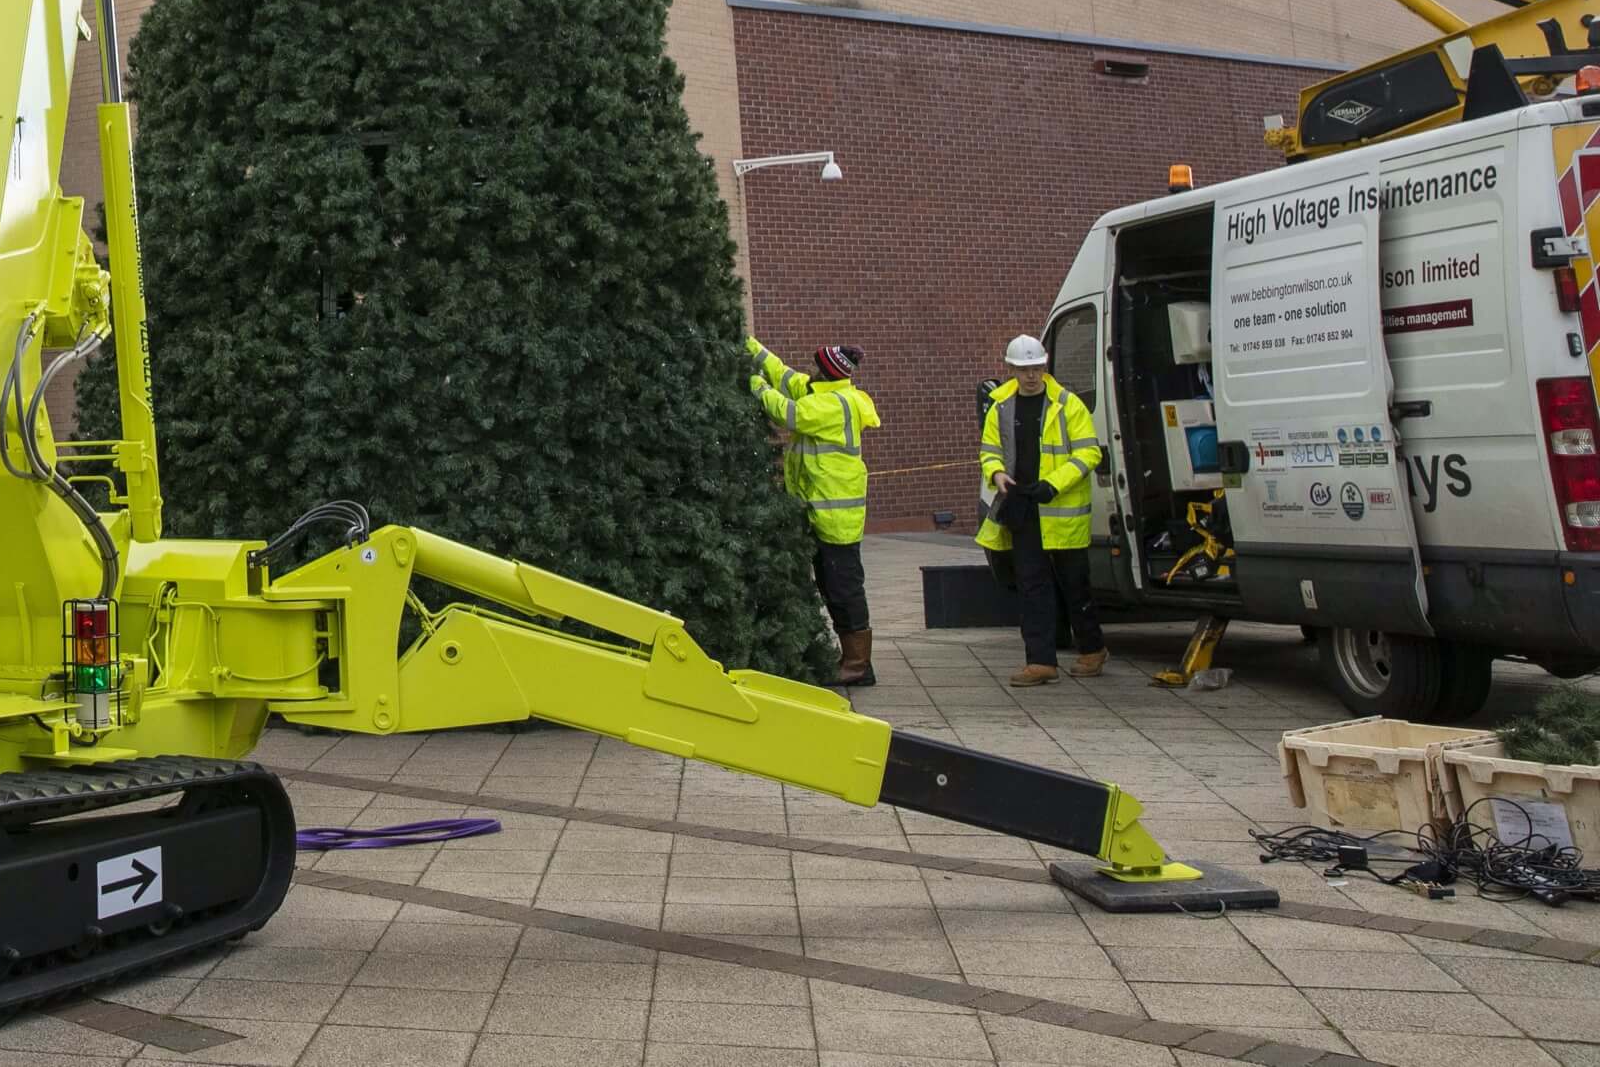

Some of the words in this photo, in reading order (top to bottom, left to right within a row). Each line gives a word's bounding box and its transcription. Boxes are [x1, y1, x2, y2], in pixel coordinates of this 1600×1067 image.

[1227, 208, 1266, 244] High
[1272, 196, 1339, 230] Voltage
[1421, 254, 1480, 284] limited
[1230, 272, 1353, 305] www.bebbingtonwilson.co.uk
[1234, 316, 1251, 329] one
[1253, 311, 1276, 327] team
[1284, 308, 1303, 321] one
[1305, 300, 1347, 318] solution
[1407, 307, 1468, 327] management
[1230, 344, 1240, 354] Tel:
[1242, 341, 1260, 352] 01745
[1262, 339, 1273, 350] 859
[1291, 334, 1305, 346] Fax:
[1306, 332, 1326, 344] 01745
[1305, 444, 1335, 463] ECA
